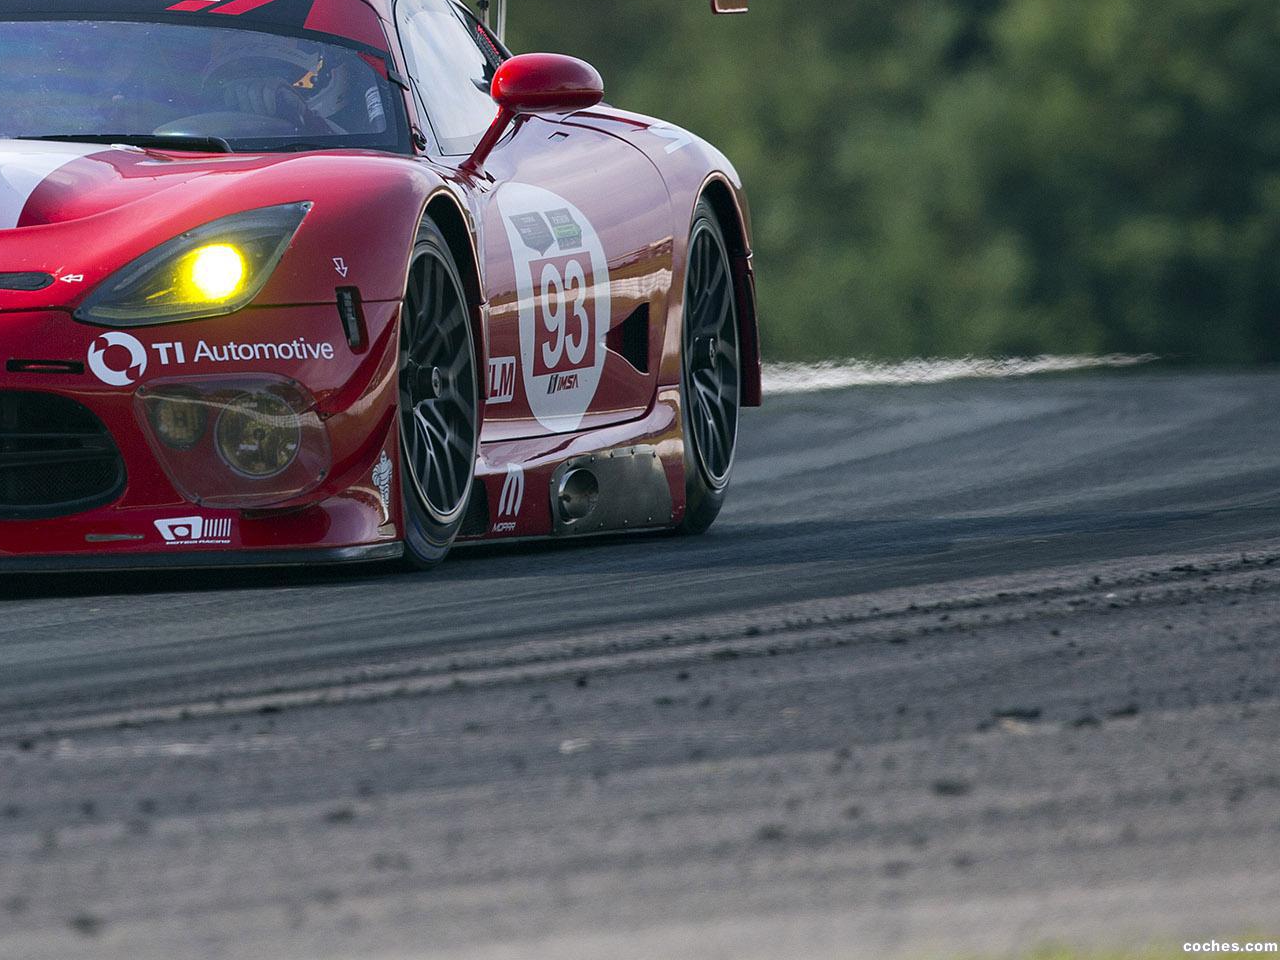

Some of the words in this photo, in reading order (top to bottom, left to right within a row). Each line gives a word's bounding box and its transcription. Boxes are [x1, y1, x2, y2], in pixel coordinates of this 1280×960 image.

[540, 259, 590, 369] 93
[151, 341, 186, 365] TI
[193, 337, 335, 362] Automotive
